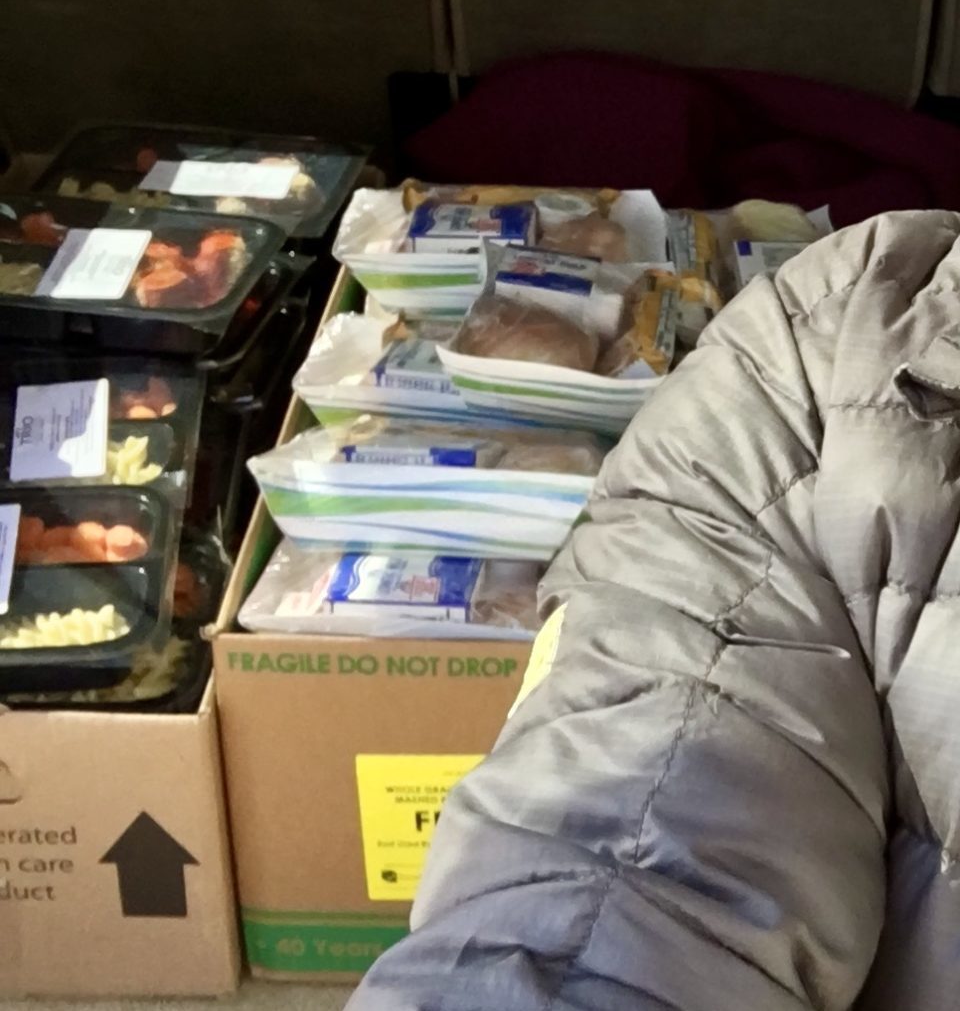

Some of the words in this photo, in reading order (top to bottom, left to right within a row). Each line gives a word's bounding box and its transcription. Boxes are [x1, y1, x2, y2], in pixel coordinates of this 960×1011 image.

[227, 651, 331, 674] FRAGILE
[337, 653, 379, 676] DO
[386, 654, 440, 678] NOT
[447, 656, 518, 678] DROP
[18, 857, 74, 874] care
